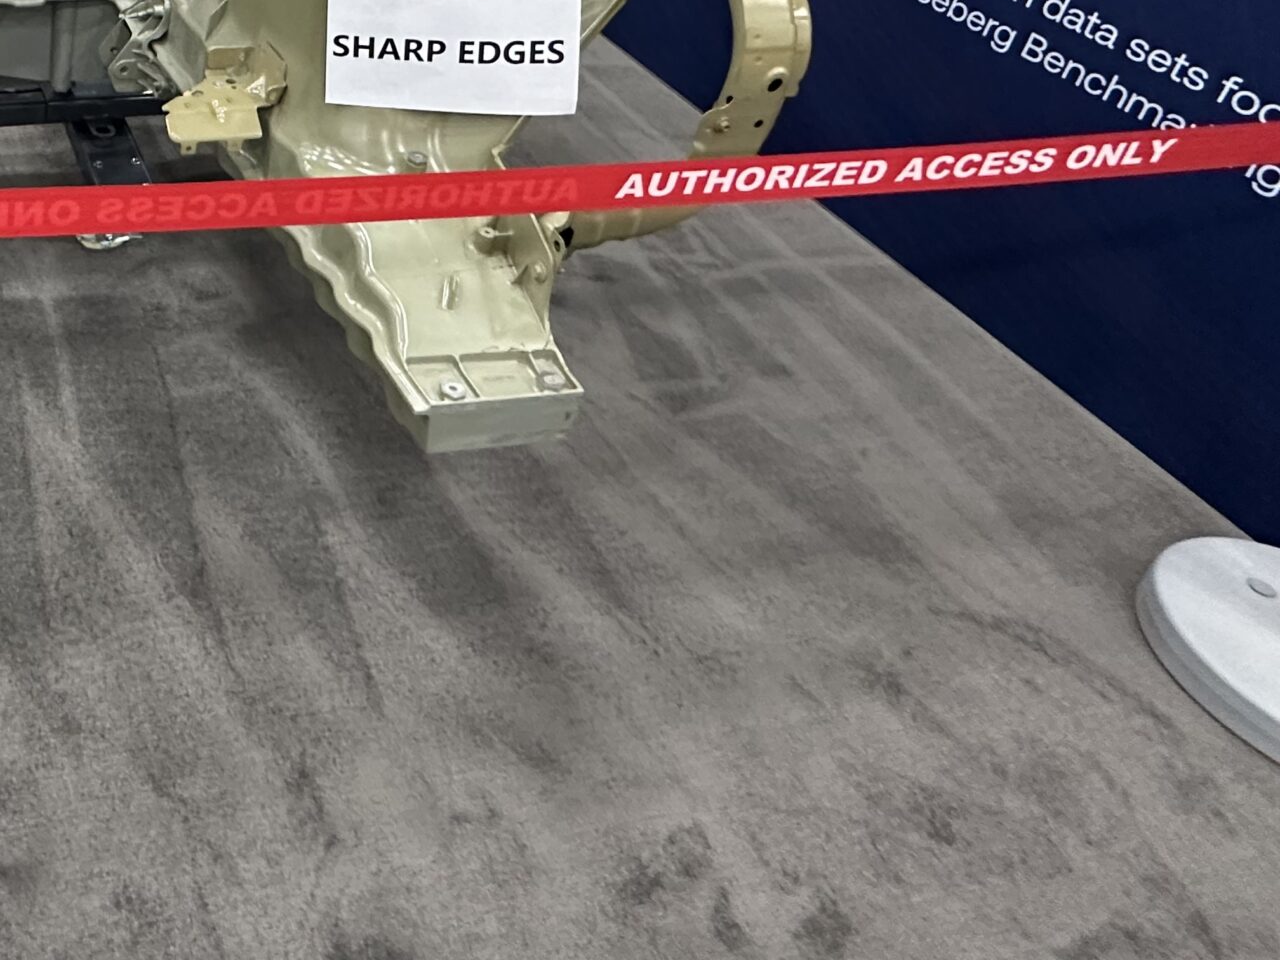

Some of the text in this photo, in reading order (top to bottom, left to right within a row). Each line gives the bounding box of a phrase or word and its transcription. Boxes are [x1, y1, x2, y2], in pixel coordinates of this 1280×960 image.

[332, 35, 565, 65] SHARP EDGES
[1125, 38, 1209, 92] sets
[615, 137, 1180, 200] AUTHORIZED ACCESS ONLY
